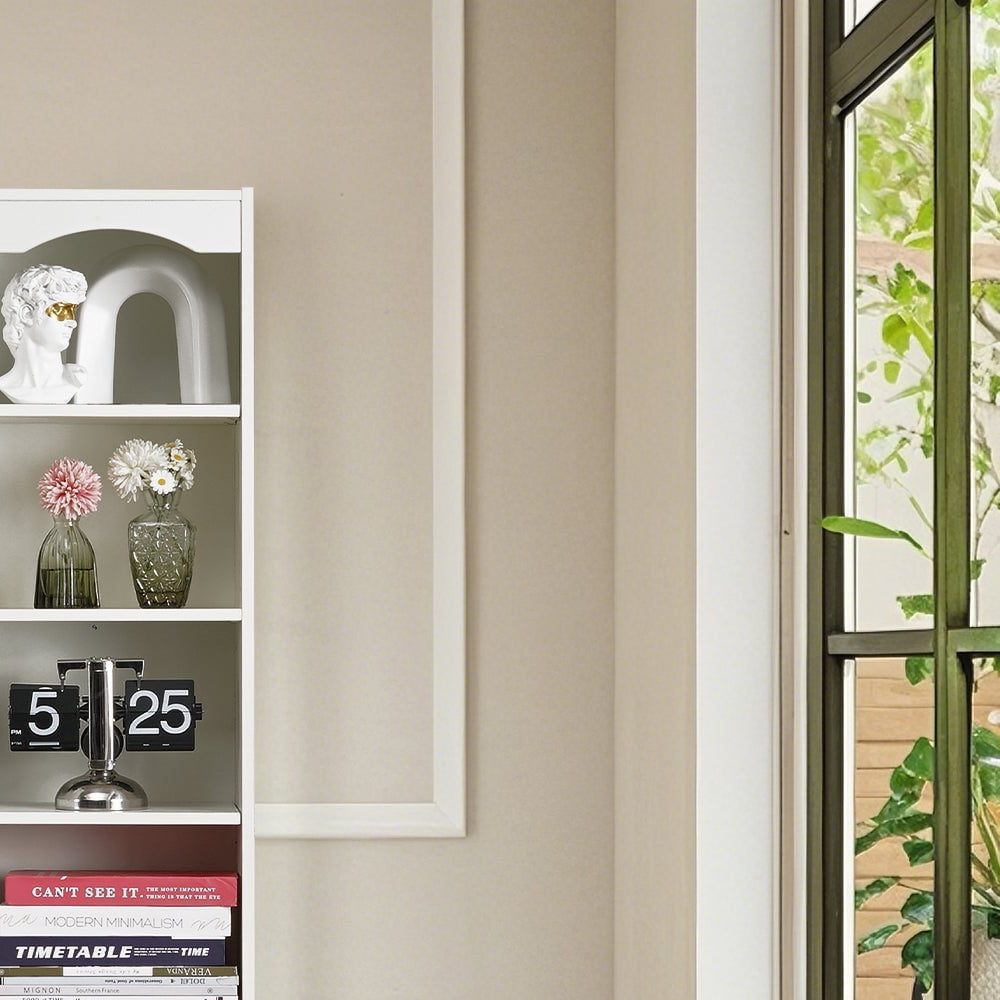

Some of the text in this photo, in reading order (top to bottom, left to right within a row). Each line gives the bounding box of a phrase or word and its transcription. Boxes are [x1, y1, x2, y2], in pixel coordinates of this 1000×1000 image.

[28, 689, 192, 736] 5 25
[31, 886, 79, 898] CAN'T
[85, 887, 116, 898] SEE
[45, 916, 103, 928] MODERN
[106, 917, 183, 929] MINIMALISM
[15, 946, 133, 959] TIMETABLE
[181, 947, 210, 957] TIME
[166, 967, 212, 976] VERANDA
